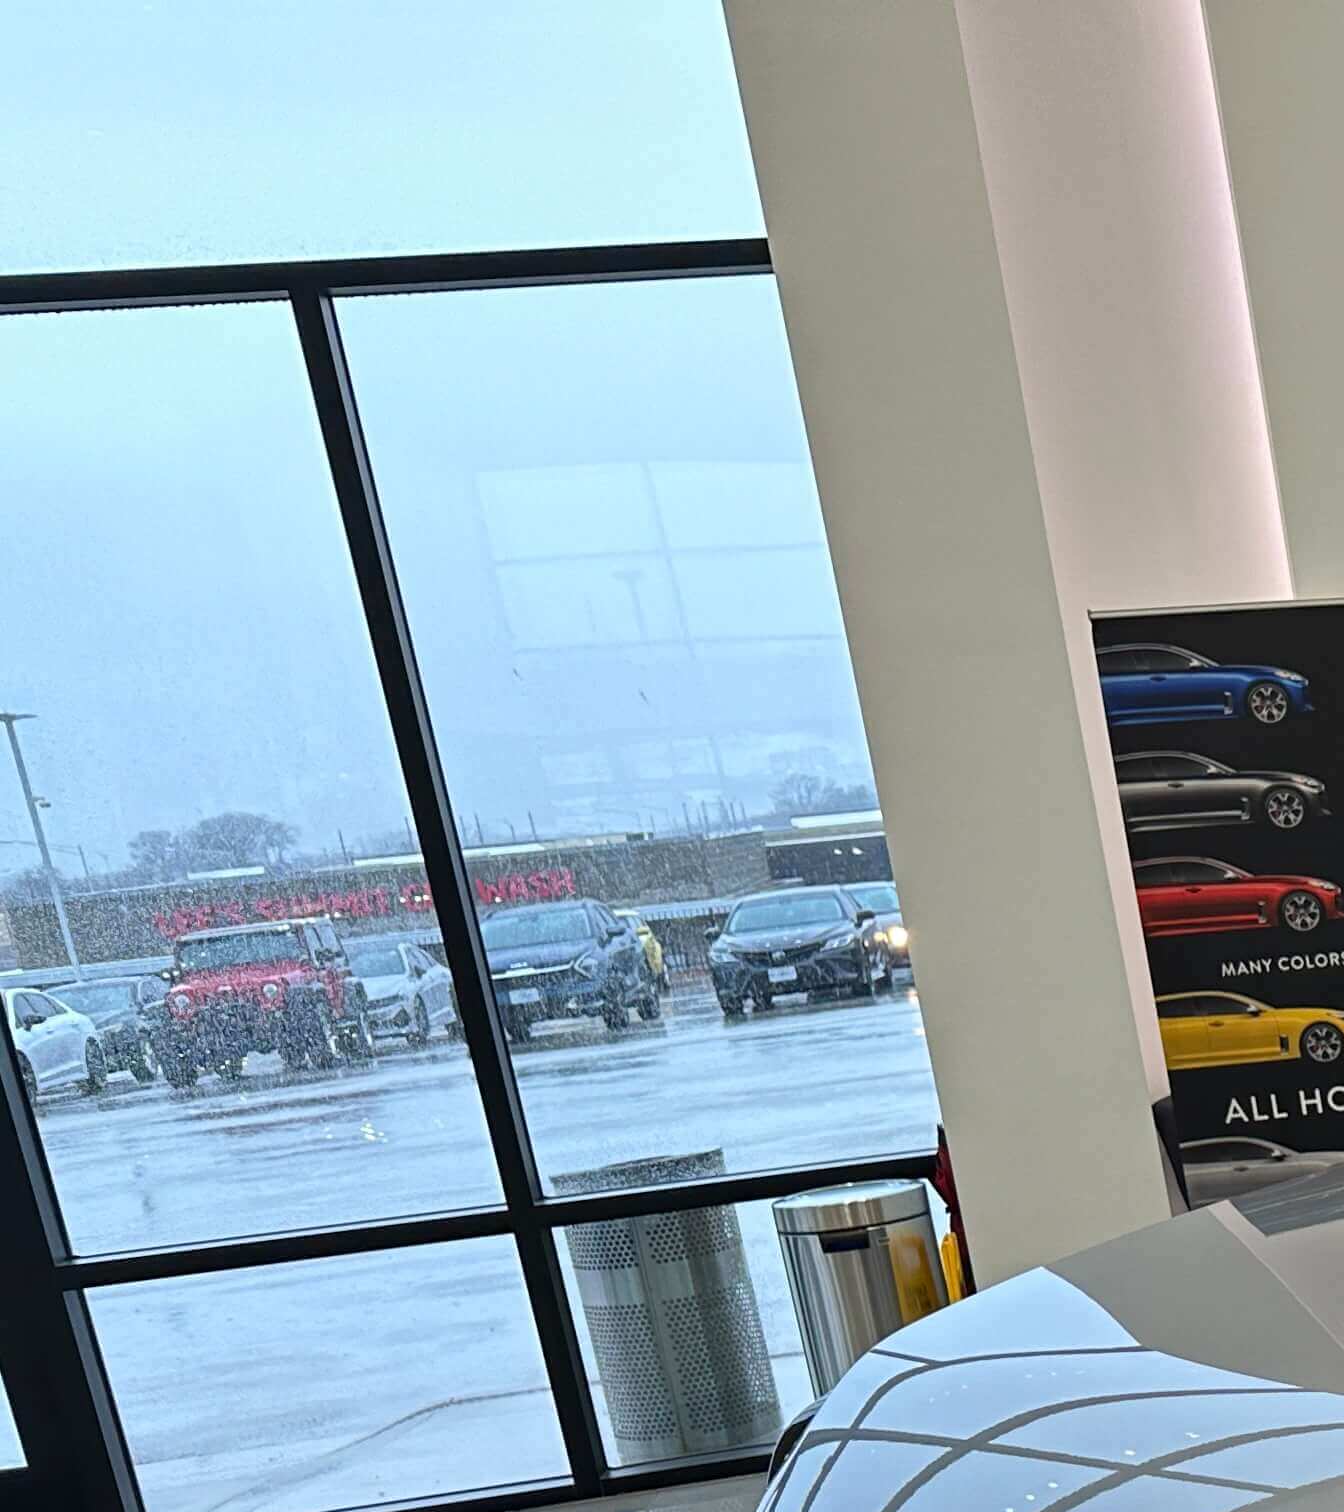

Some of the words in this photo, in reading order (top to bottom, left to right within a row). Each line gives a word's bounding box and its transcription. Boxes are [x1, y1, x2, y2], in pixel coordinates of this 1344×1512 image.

[475, 868, 577, 905] WASH
[1221, 958, 1273, 978] MANY
[1225, 1093, 1289, 1125] ALL
